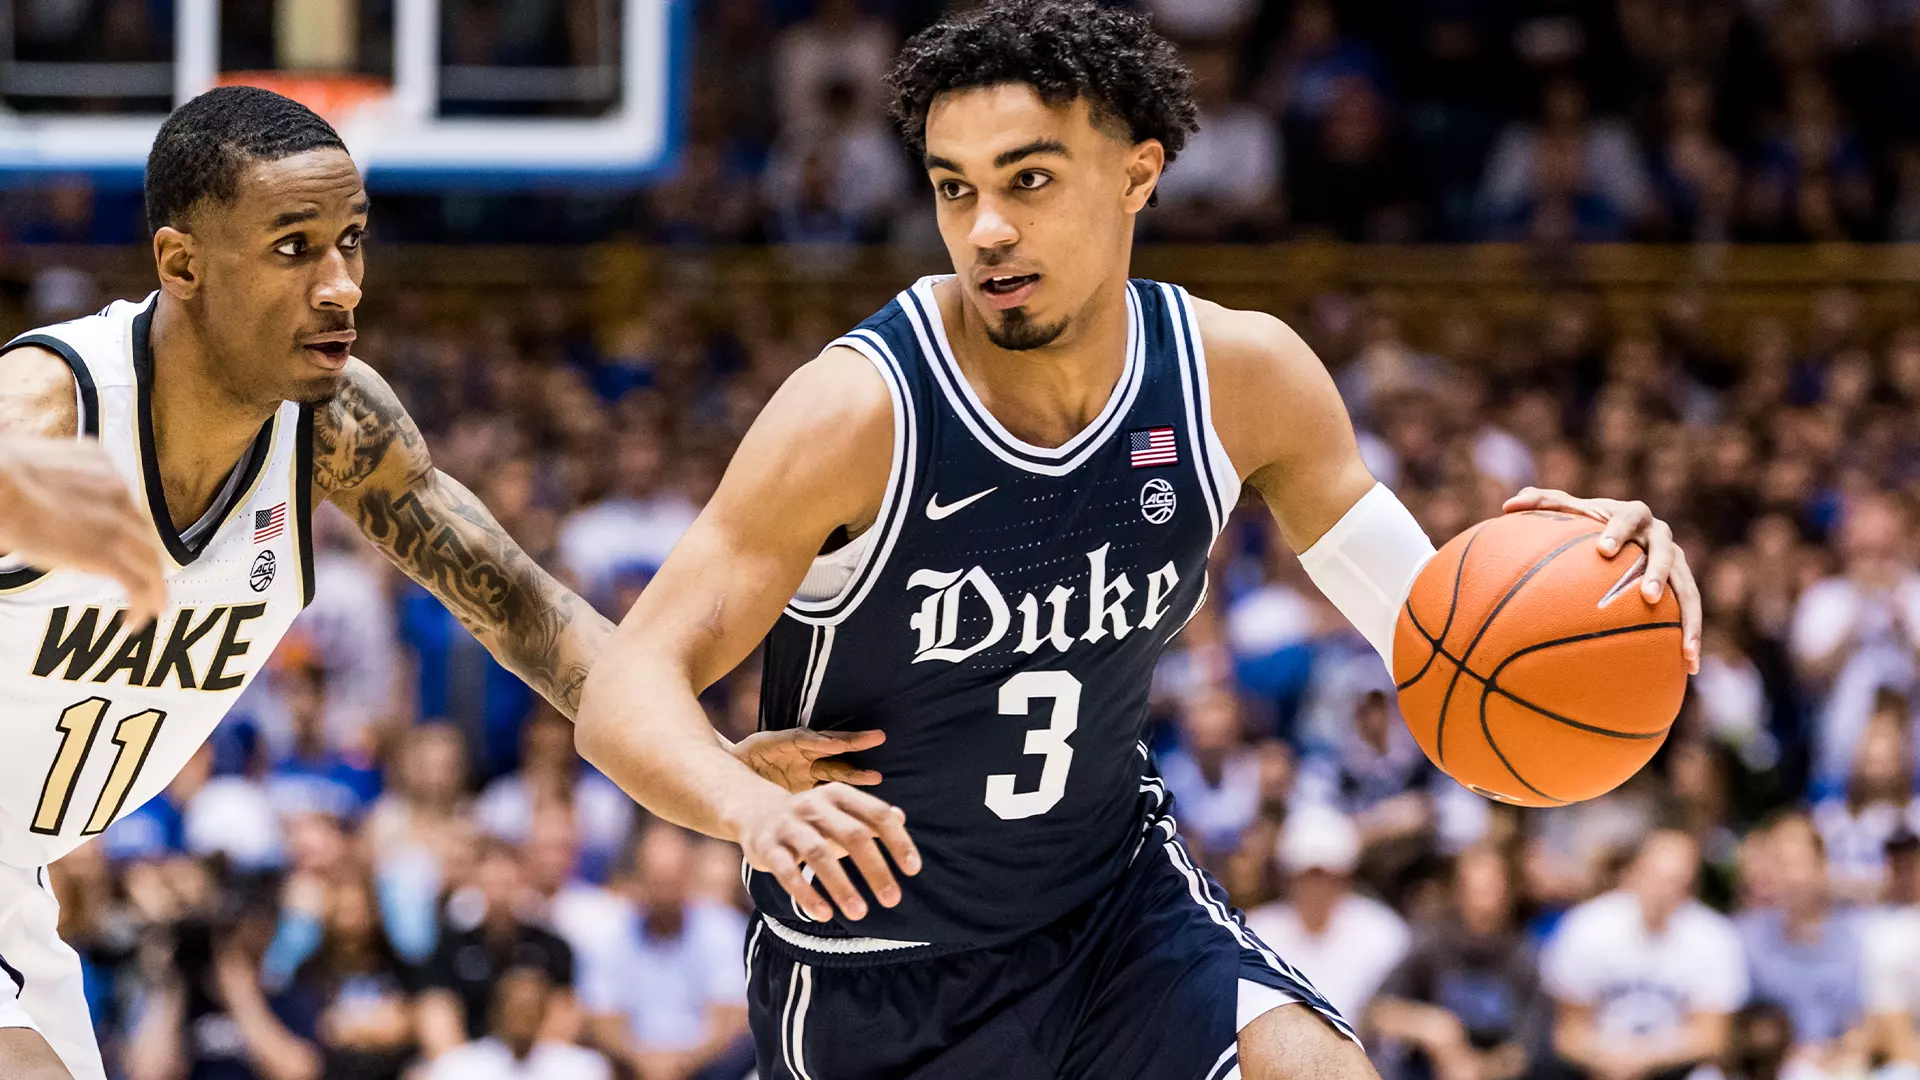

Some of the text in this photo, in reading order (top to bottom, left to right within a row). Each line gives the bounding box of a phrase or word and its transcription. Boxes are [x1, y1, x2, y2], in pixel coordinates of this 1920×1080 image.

[1145, 491, 1175, 505] ACC
[253, 561, 275, 575] ACC
[906, 541, 1180, 664] Duke
[30, 600, 268, 692] WAKE
[29, 696, 167, 836] 11
[984, 670, 1083, 820] 3
